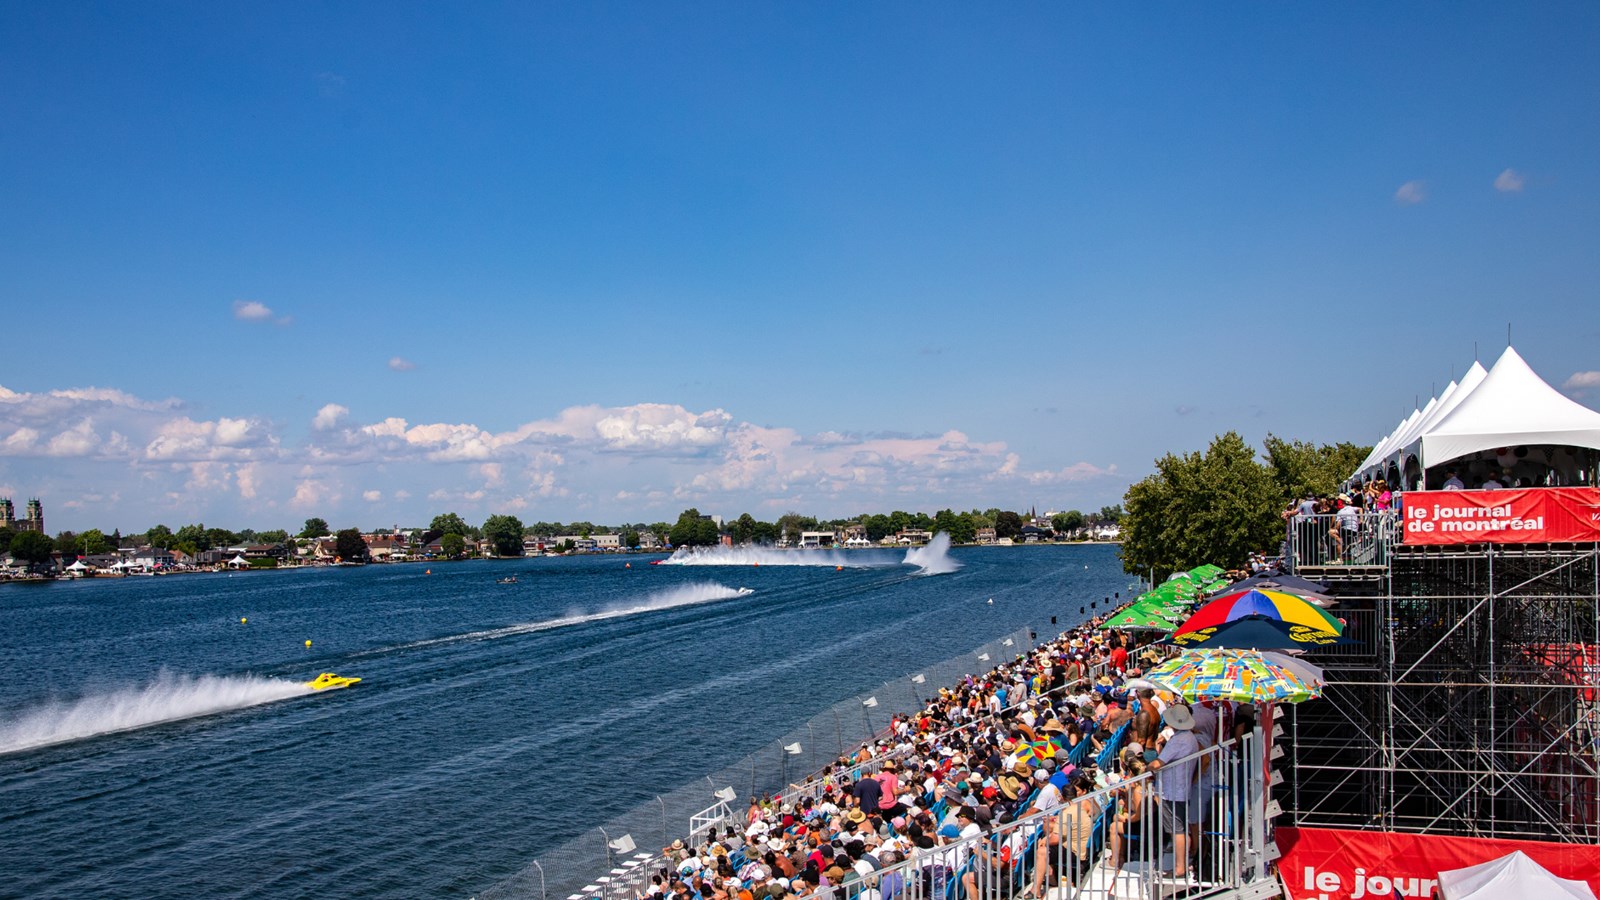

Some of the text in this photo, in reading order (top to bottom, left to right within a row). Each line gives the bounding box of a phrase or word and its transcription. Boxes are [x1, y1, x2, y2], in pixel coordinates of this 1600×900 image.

[1407, 504, 1512, 521] le journal
[1407, 516, 1544, 533] de montréal
[1304, 866, 1341, 892] le
